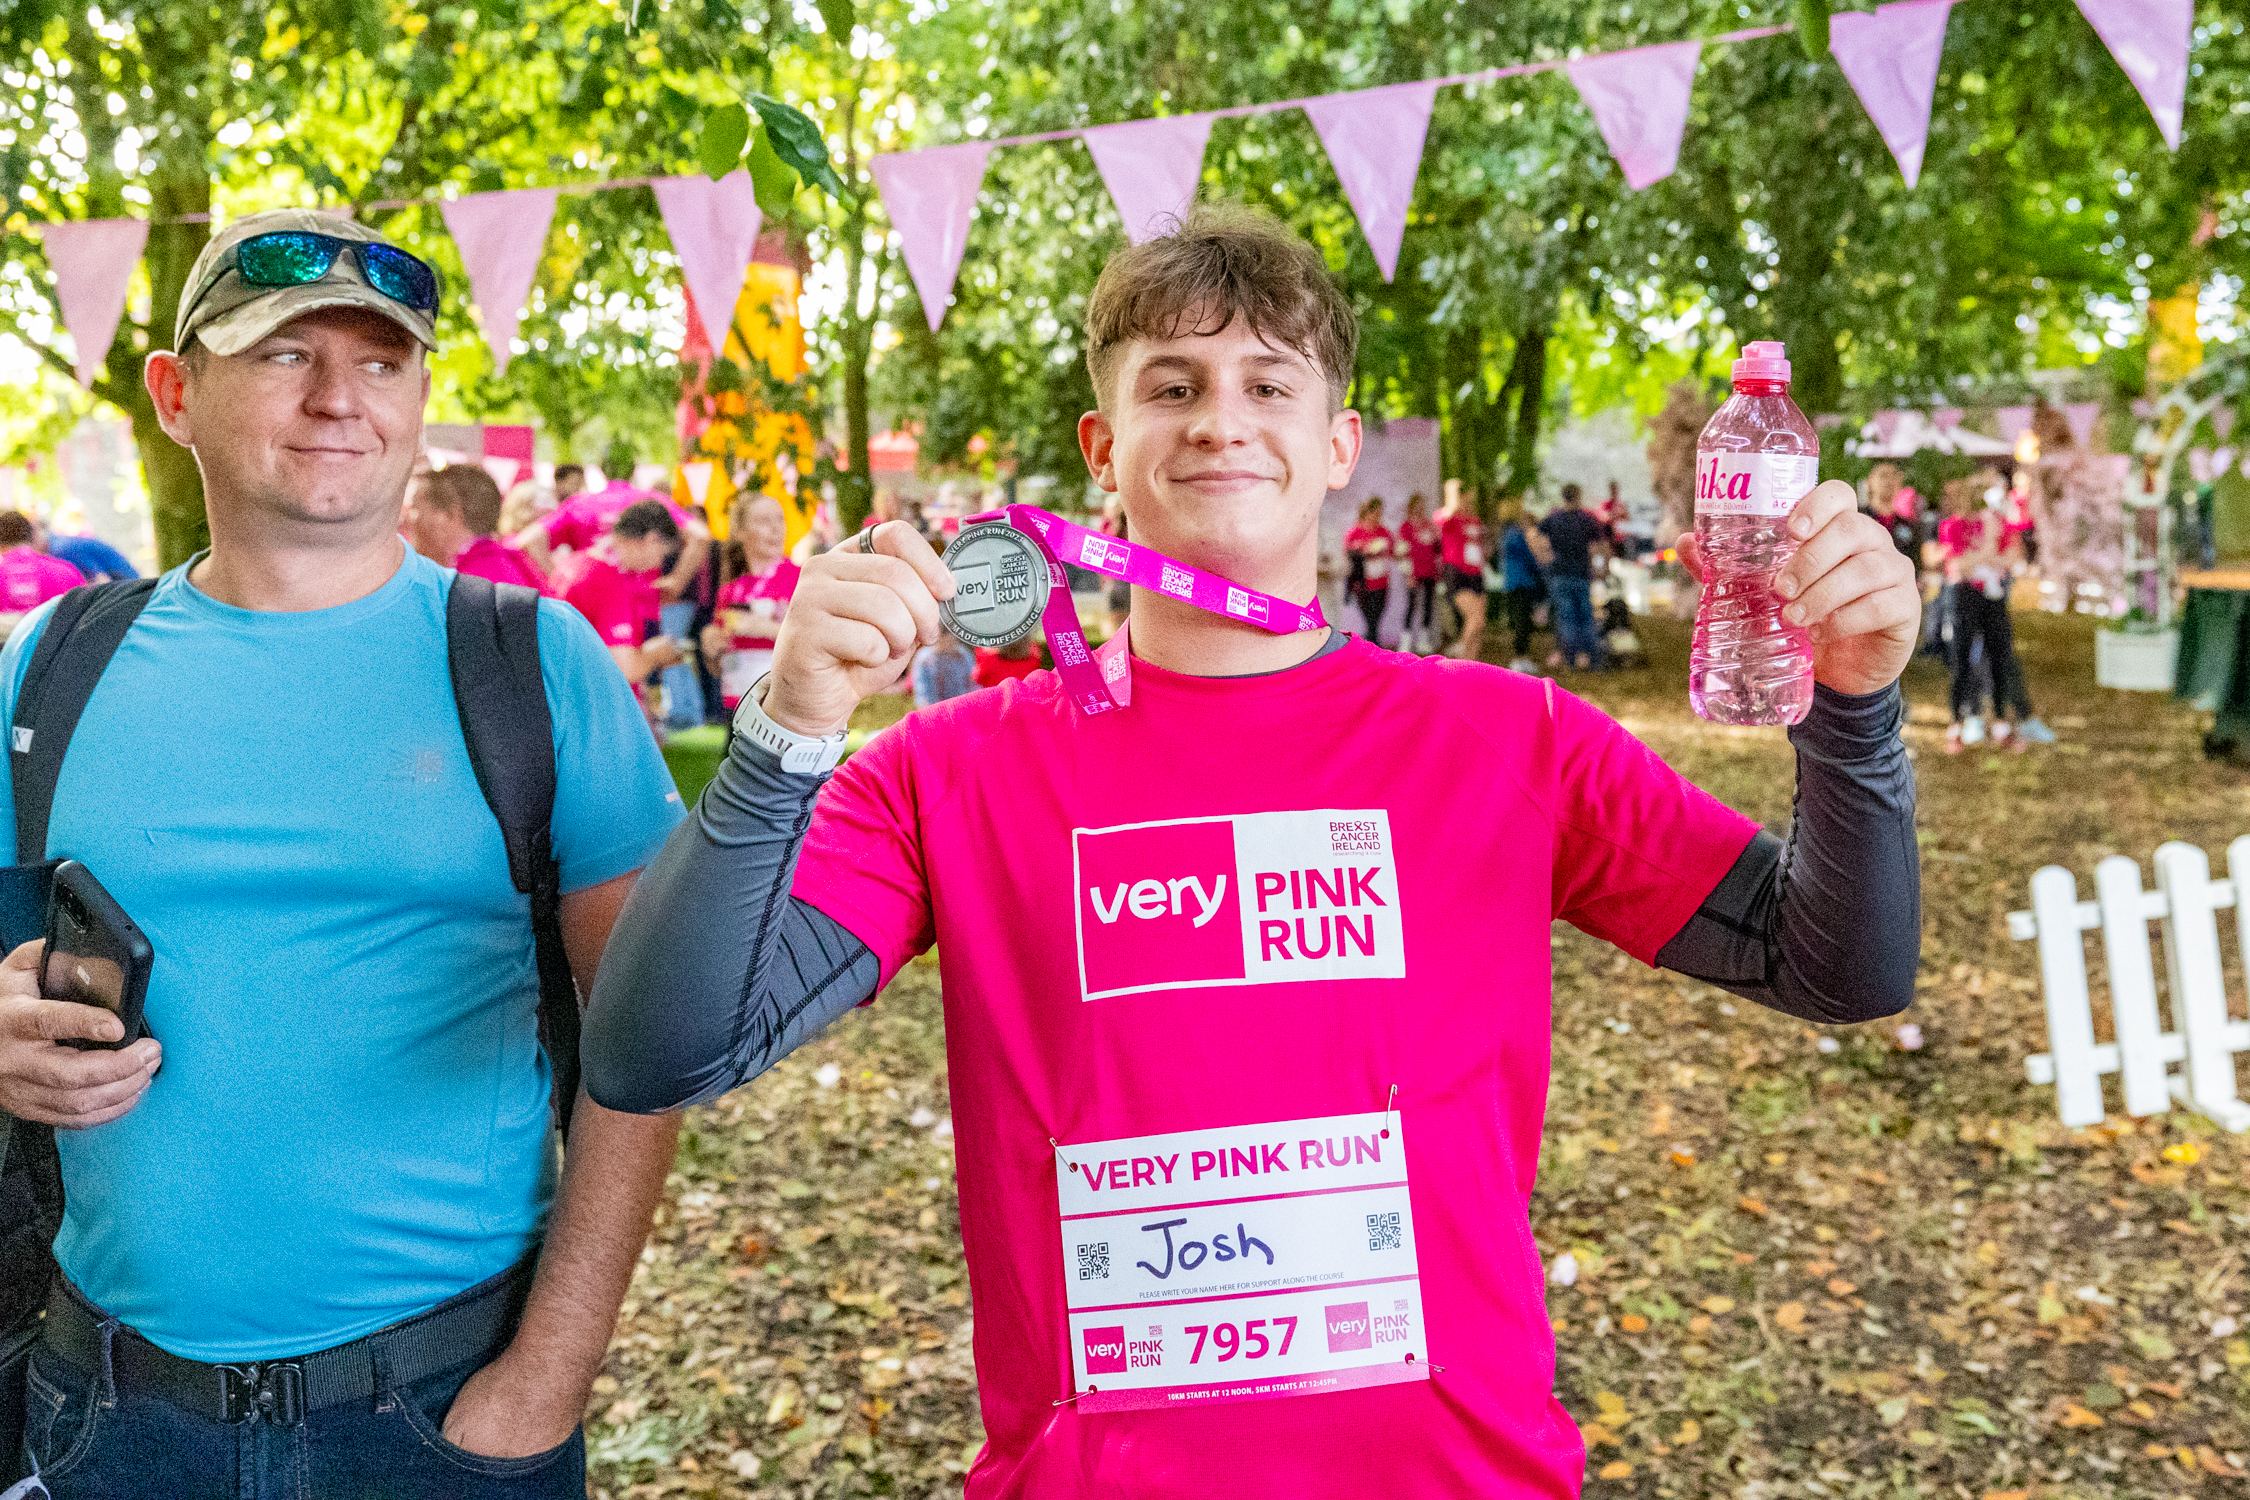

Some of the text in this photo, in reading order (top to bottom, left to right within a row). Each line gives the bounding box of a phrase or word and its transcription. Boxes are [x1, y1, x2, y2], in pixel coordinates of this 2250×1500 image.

[1031, 517, 1050, 531] IREL
[949, 536, 966, 555] VERY
[966, 528, 985, 541] PINK
[987, 527, 1005, 535] RUN
[1006, 530, 1024, 542] 2023
[1105, 551, 1125, 565] very
[995, 574, 1029, 590] PINK
[1162, 566, 1194, 583] IRELAND
[957, 581, 989, 596] very
[996, 587, 1027, 603] RUN
[1248, 602, 1267, 614] very
[952, 624, 977, 643] MADE
[989, 606, 1041, 645] DIFFERENCE
[1054, 633, 1073, 667] IRELAND
[1062, 632, 1081, 665] CANCER
[1331, 832, 1379, 842] CANCER
[1332, 841, 1381, 851] IRELAND
[1255, 867, 1388, 913] PINK
[1090, 874, 1227, 929] very
[1259, 914, 1376, 962] RUN
[1081, 1134, 1382, 1192] VERY PINK RUN
[1136, 1218, 1275, 1280] Josh
[1139, 1290, 1161, 1299] PLEASE
[1162, 1289, 1179, 1297] WRITE
[1181, 1287, 1198, 1295] YOUR
[1199, 1285, 1218, 1293] NAME
[1219, 1283, 1235, 1291] HERE
[1251, 1279, 1281, 1288] SUPPORT
[1282, 1276, 1305, 1285] ALONG
[1306, 1274, 1318, 1282] THE
[1319, 1272, 1344, 1281] COURSE
[1329, 1318, 1367, 1336] very
[1374, 1313, 1410, 1330] PINK
[1184, 1316, 1298, 1364] 7957
[1375, 1327, 1407, 1343] RUN
[1087, 1342, 1123, 1359] very
[1129, 1339, 1164, 1354] PINK
[1131, 1354, 1162, 1368] RUN
[1167, 1392, 1185, 1400] 10KM
[1186, 1390, 1210, 1399] STARTS
[1211, 1389, 1220, 1397] AT
[1231, 1387, 1254, 1395] NOON,
[1255, 1385, 1271, 1393] 5KM
[1272, 1382, 1297, 1392] STARTS
[1309, 1378, 1338, 1387] 12:45PM
